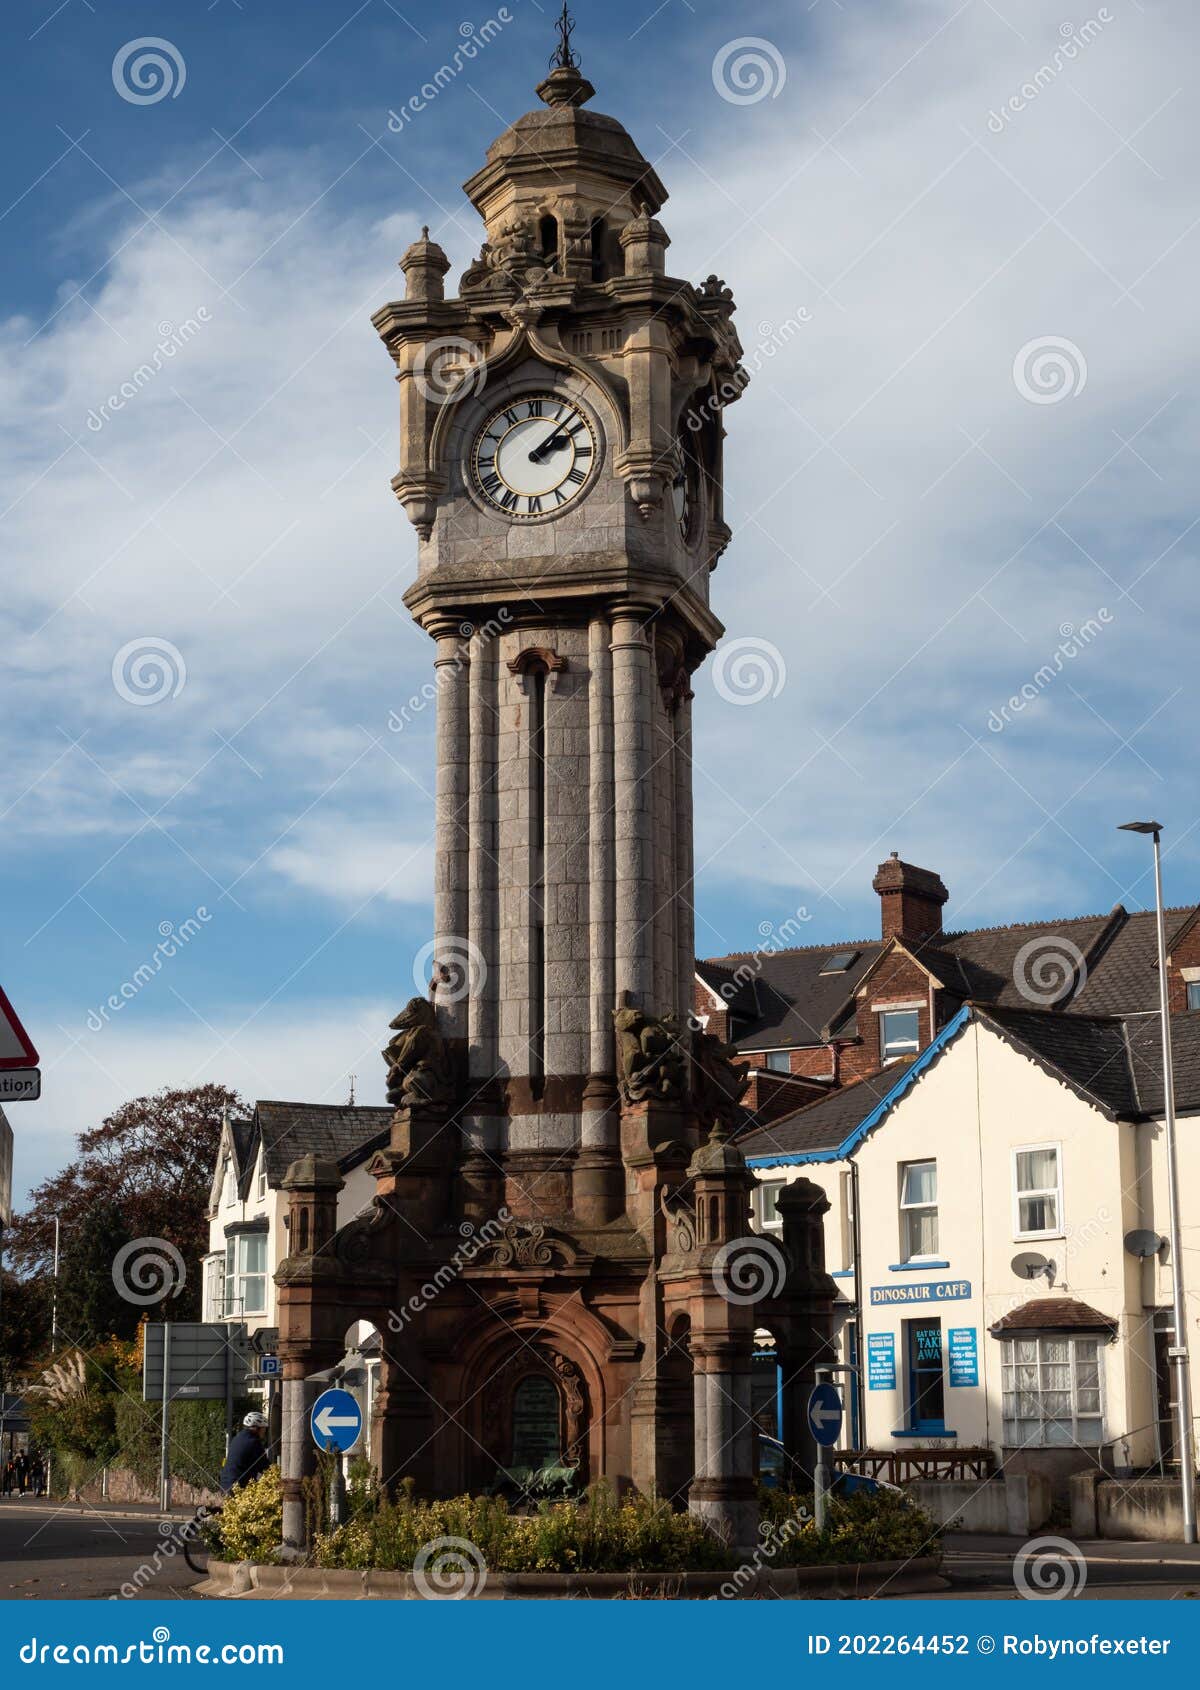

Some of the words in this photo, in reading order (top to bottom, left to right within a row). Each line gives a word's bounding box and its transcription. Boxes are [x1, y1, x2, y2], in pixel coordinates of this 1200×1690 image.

[528, 400, 542, 418] XII
[0, 1079, 33, 1092] tion
[873, 1286, 931, 1302] DINOSAUR
[936, 1283, 968, 1297] CAFE
[917, 1349, 942, 1361] AWA
[266, 1361, 275, 1373] P
